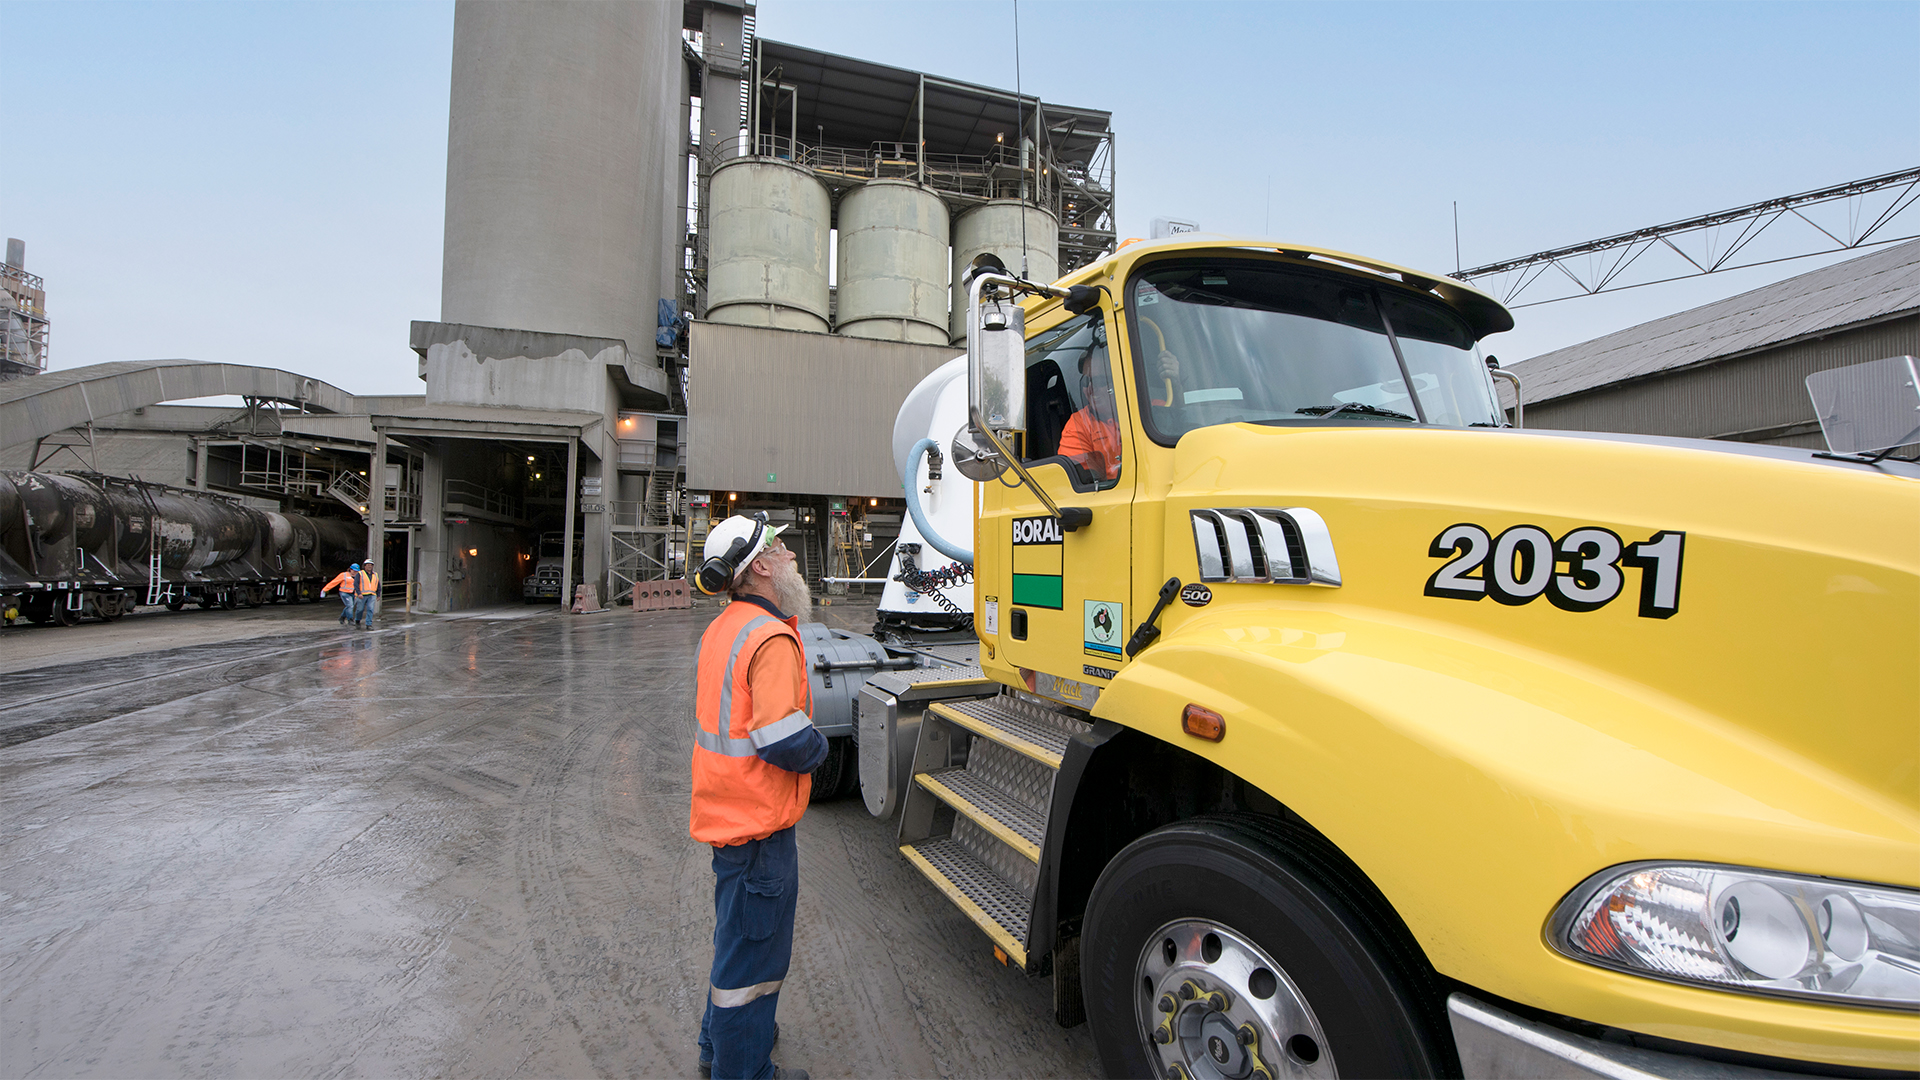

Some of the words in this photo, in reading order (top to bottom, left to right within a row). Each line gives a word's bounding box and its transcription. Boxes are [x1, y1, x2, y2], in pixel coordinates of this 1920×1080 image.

[582, 504, 606, 512] SILOS
[1013, 518, 1063, 543] BORAL
[1424, 523, 1686, 619] 2031
[1181, 590, 1212, 601] 500
[1053, 677, 1083, 700] Mack
